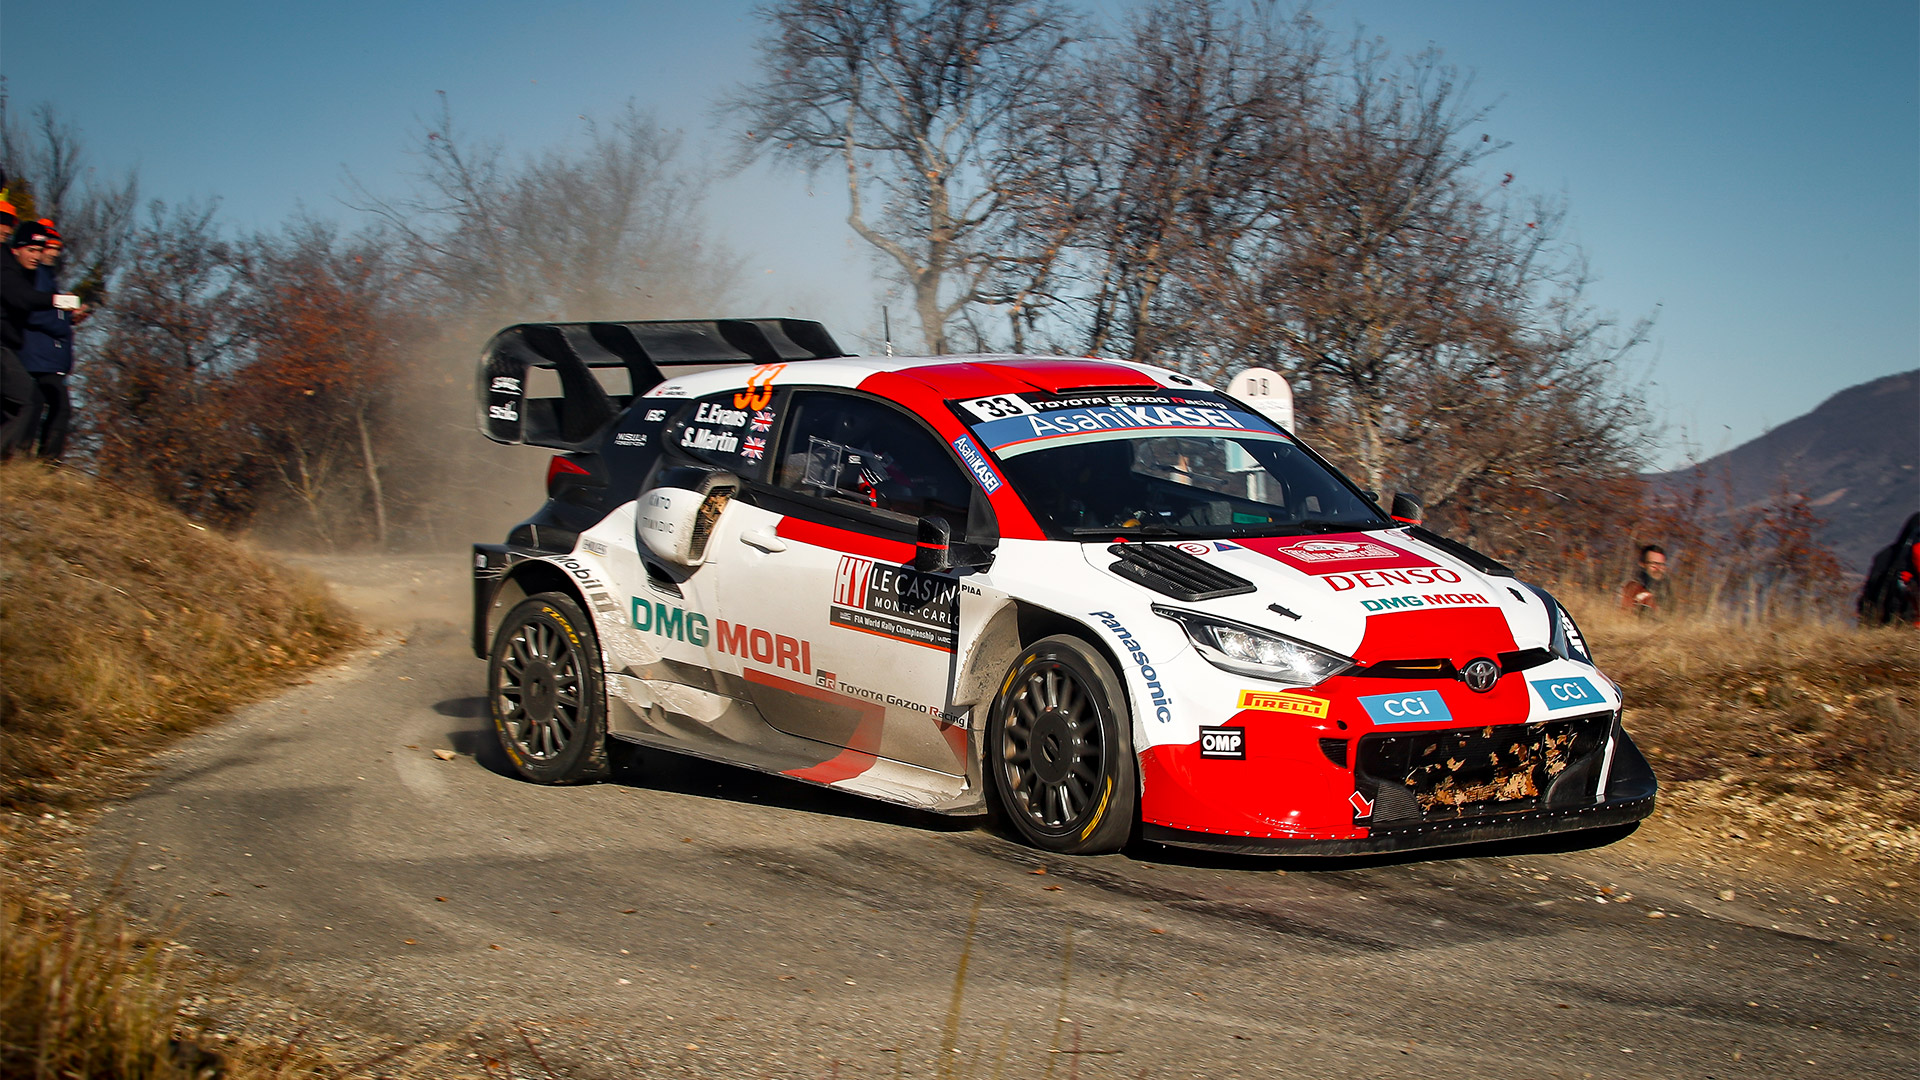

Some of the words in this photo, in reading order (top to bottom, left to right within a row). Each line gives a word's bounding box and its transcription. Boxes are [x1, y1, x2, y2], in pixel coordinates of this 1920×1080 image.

[733, 363, 788, 411] 33
[694, 402, 749, 427] E.Evans
[975, 397, 1023, 417] 33
[1029, 396, 1104, 410] TOYOTA
[1106, 394, 1169, 404] GAZOO
[1170, 396, 1228, 410] Racing
[1027, 406, 1245, 437] AsahiKASEI
[680, 426, 739, 453] S.Martin
[954, 437, 1000, 492] AsahiKASEI
[551, 555, 604, 589] Mobil
[834, 555, 872, 607] HY
[1321, 568, 1462, 592] DENSO
[871, 568, 893, 593] LE
[894, 573, 960, 607] CASIN
[961, 584, 982, 596] PIAA
[1360, 595, 1424, 612] DMG
[1421, 593, 1489, 605] MORI
[631, 596, 710, 648] DMG
[716, 618, 812, 675] MORI
[854, 615, 864, 624] FIA
[864, 617, 880, 628] World
[881, 621, 895, 633] Rally
[896, 624, 934, 642] Championship
[1088, 611, 1171, 724] Panasonic
[838, 681, 884, 702] TOYOTA
[886, 694, 927, 713] GAZOO
[929, 706, 965, 727] Racing
[1243, 692, 1323, 714] PIRELLI
[1202, 734, 1242, 752] OMP
